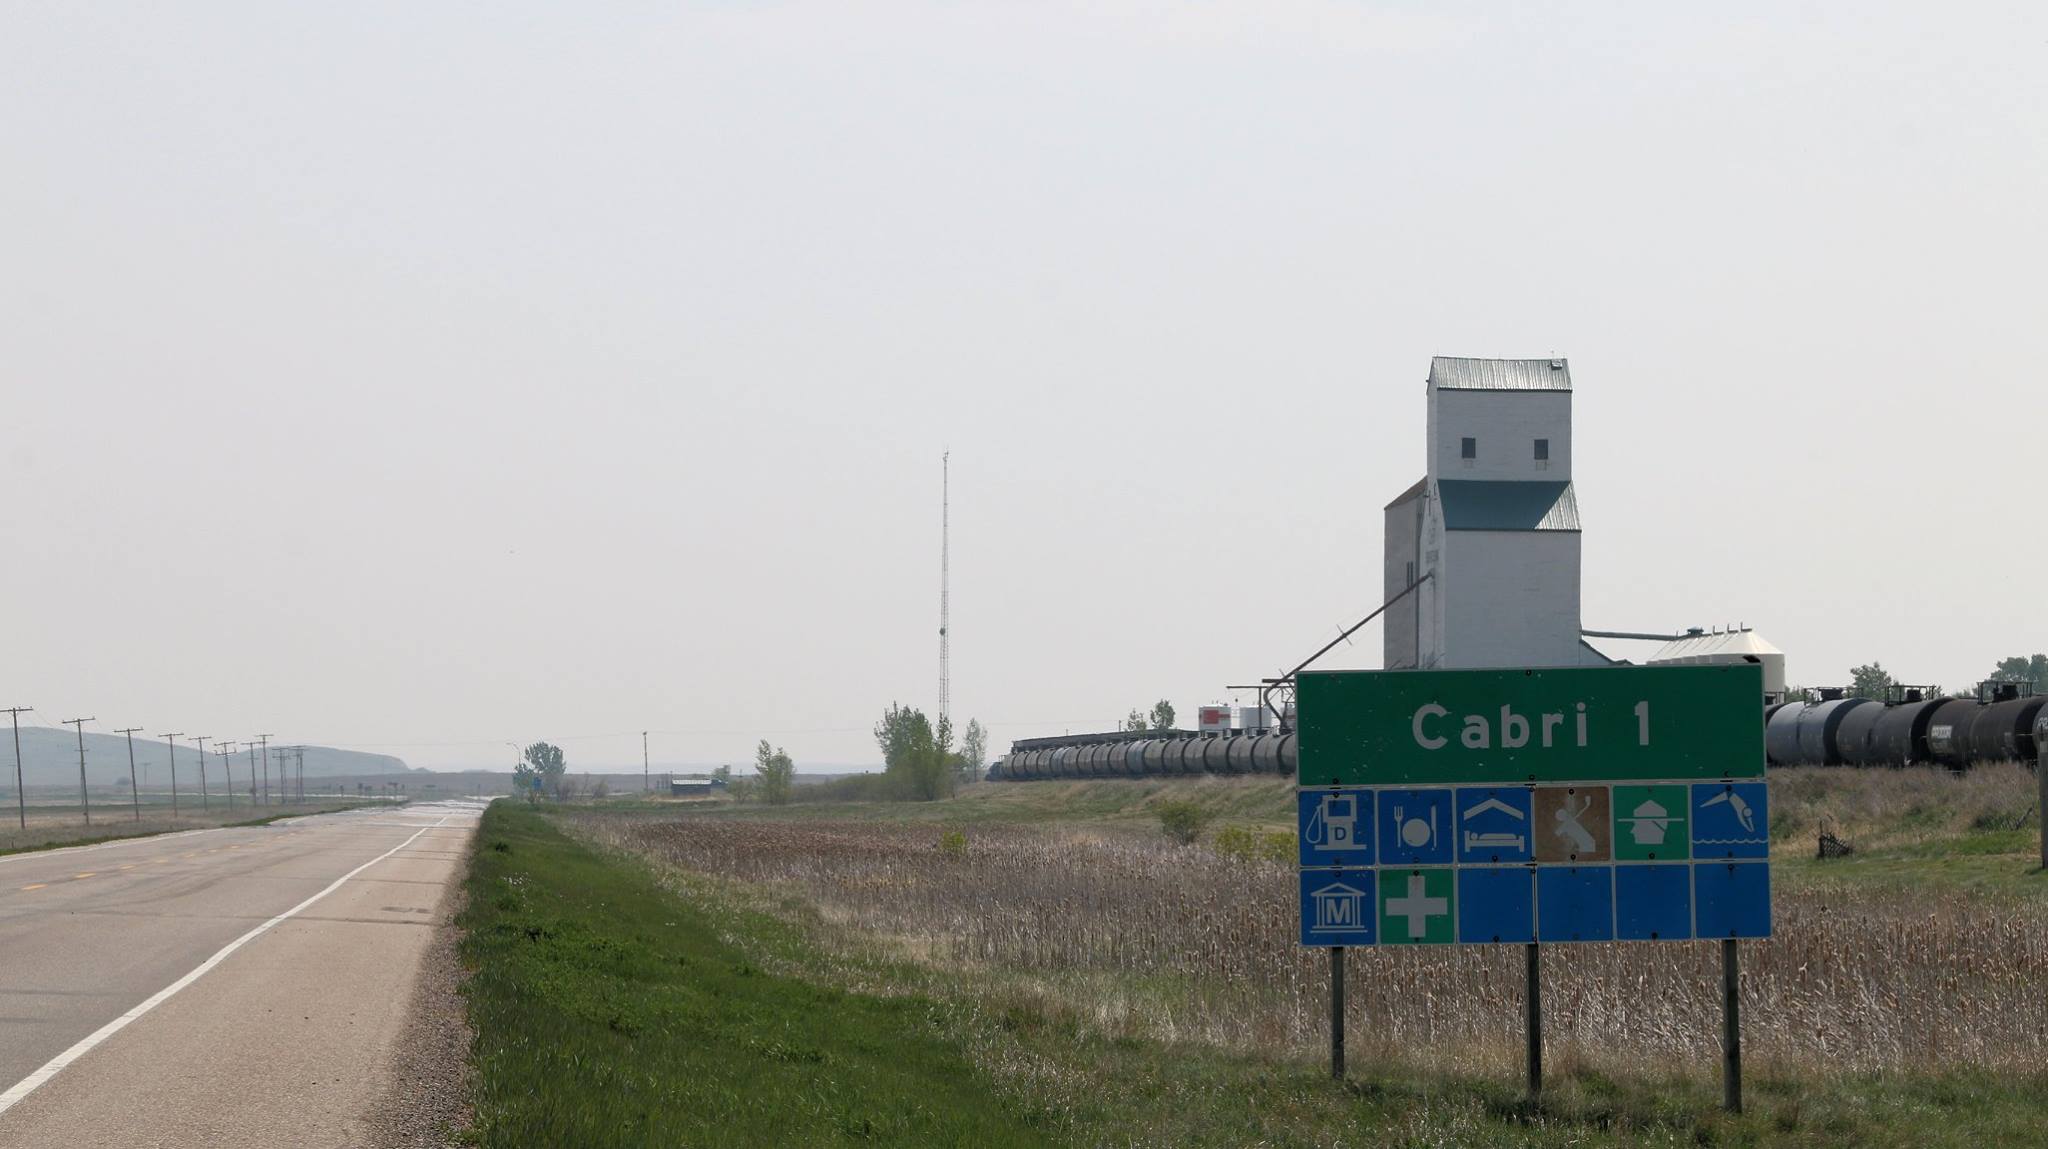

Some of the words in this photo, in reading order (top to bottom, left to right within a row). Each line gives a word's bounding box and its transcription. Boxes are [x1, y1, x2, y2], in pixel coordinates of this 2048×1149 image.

[1412, 702, 1587, 750] Cabri
[1634, 700, 1650, 746] 1
[1334, 826, 1347, 841] D
[1326, 898, 1351, 924] M
